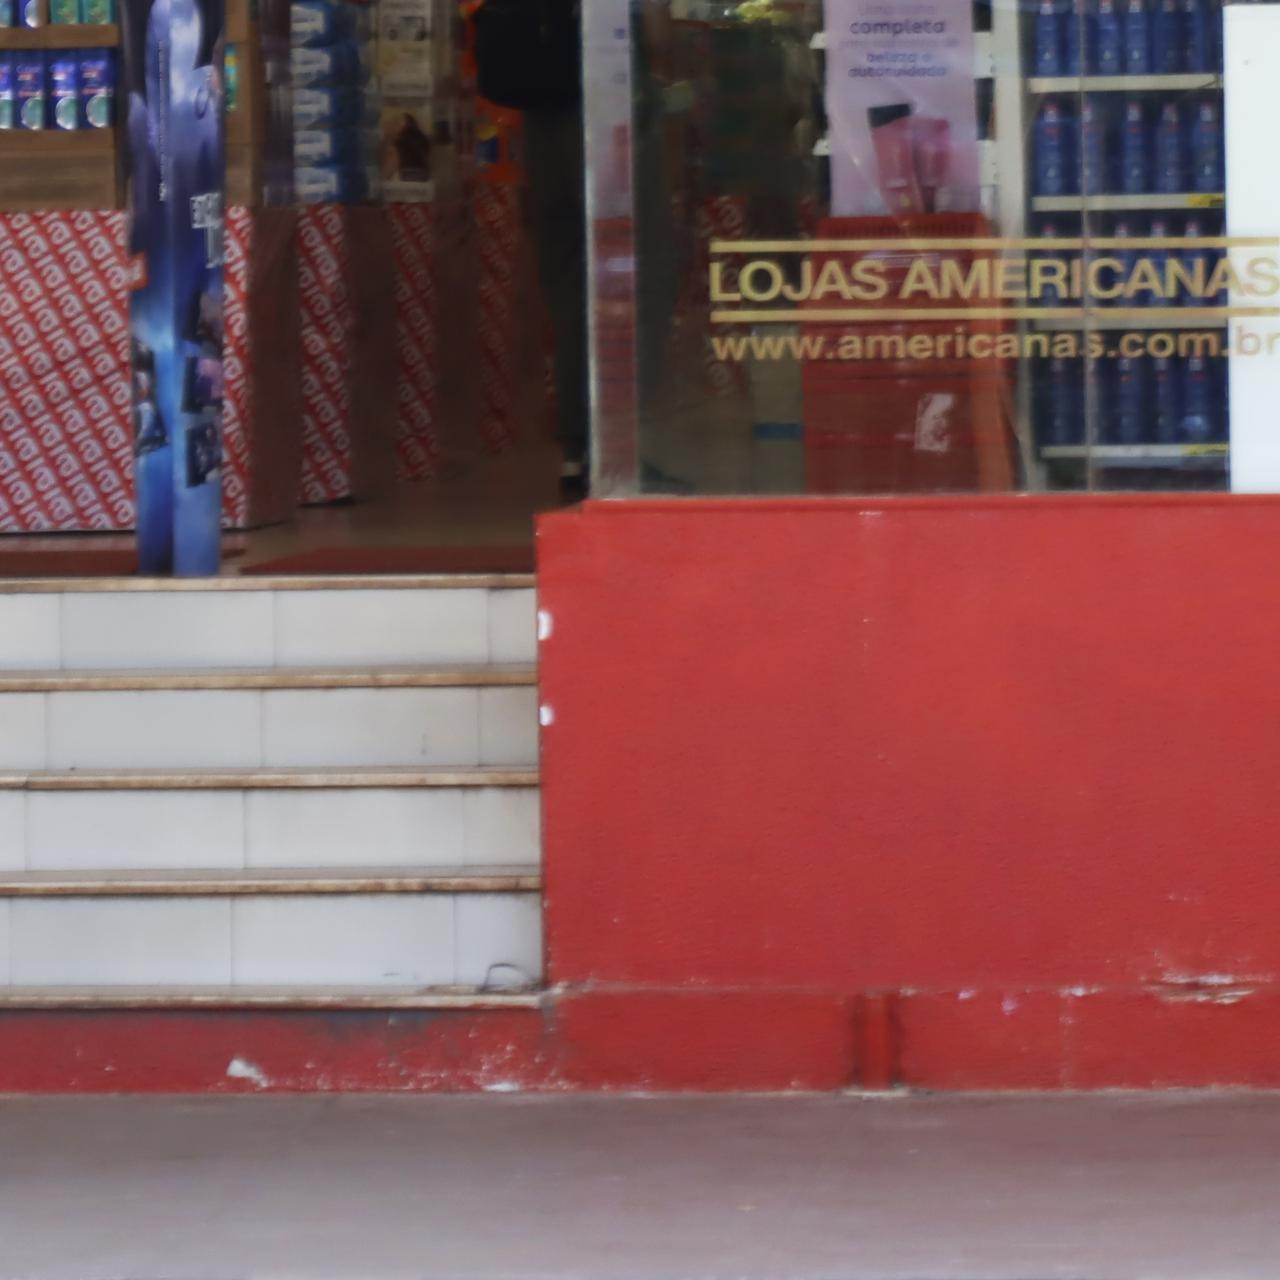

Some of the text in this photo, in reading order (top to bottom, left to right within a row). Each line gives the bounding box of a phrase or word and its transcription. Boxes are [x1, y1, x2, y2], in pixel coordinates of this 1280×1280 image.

[849, 21, 945, 36] completa
[709, 257, 1280, 301] LOJAS AMERICANAS
[711, 325, 1280, 361] www.americanas.com.br
